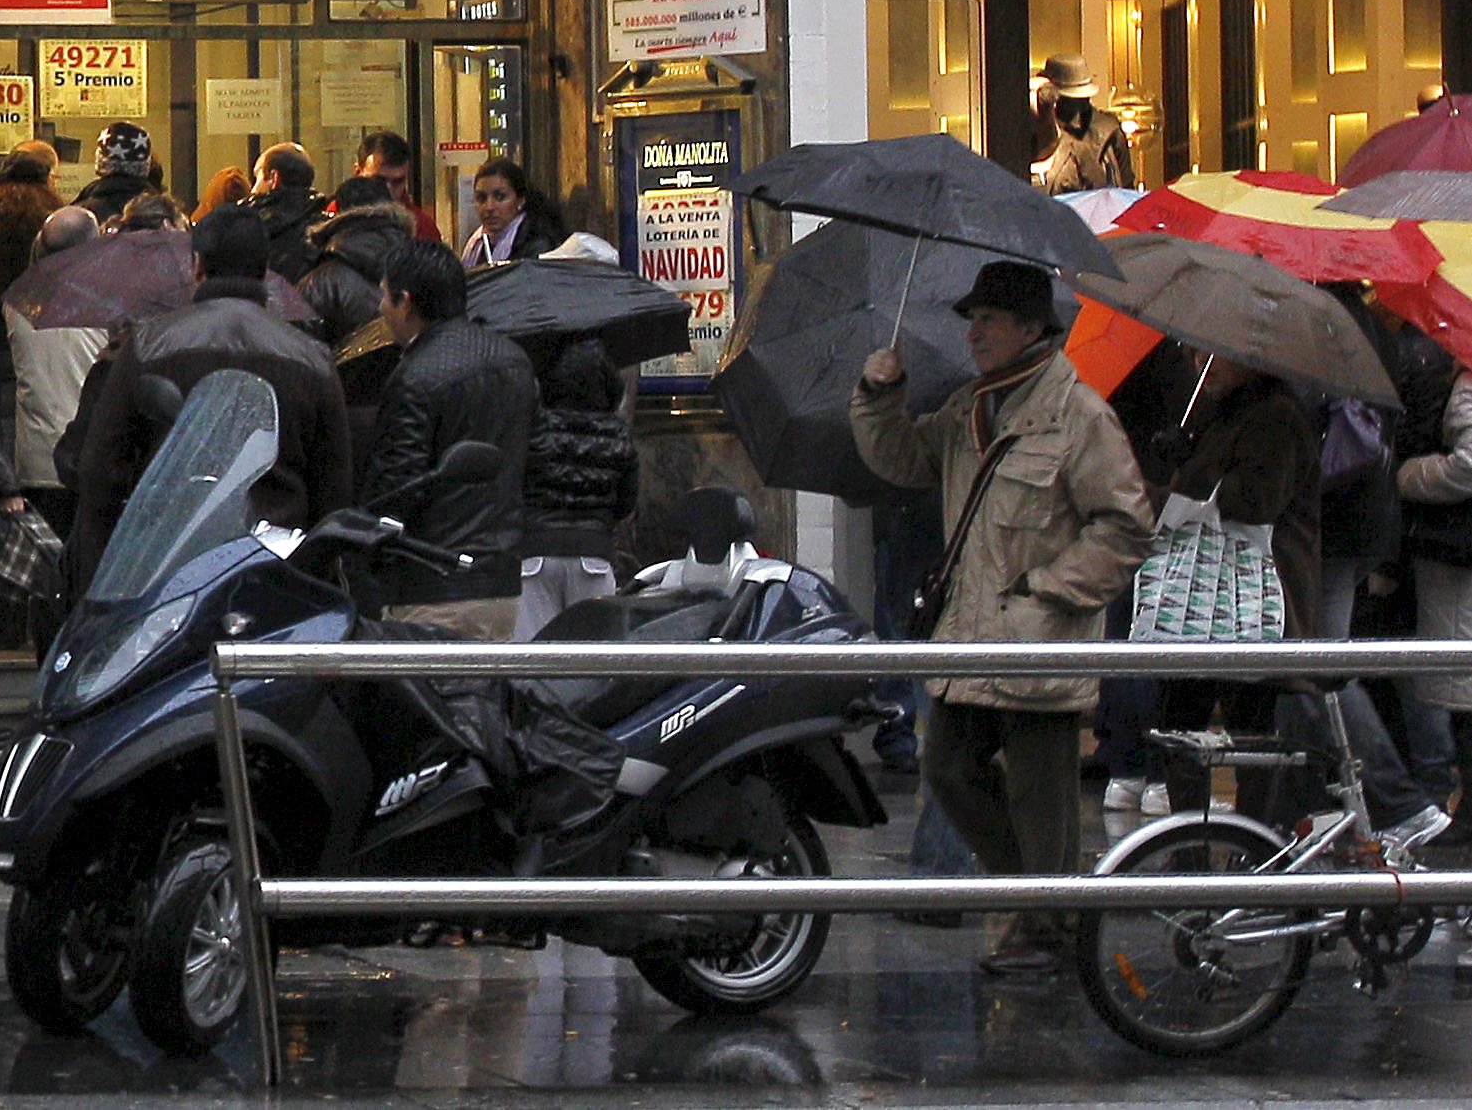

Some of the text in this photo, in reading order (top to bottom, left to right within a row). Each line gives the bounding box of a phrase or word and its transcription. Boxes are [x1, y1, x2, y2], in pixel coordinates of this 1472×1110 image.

[679, 10, 721, 23] millones
[723, 7, 736, 19] de
[49, 45, 136, 69] 49271
[74, 73, 134, 88] Premio
[644, 139, 729, 168] DOÑA MANOLITA
[646, 211, 720, 225] A LA VENTA
[646, 228, 720, 242] LOTERÍA DE
[641, 246, 725, 282] NAVIDAD
[682, 290, 724, 318] 79
[688, 322, 722, 339] emio
